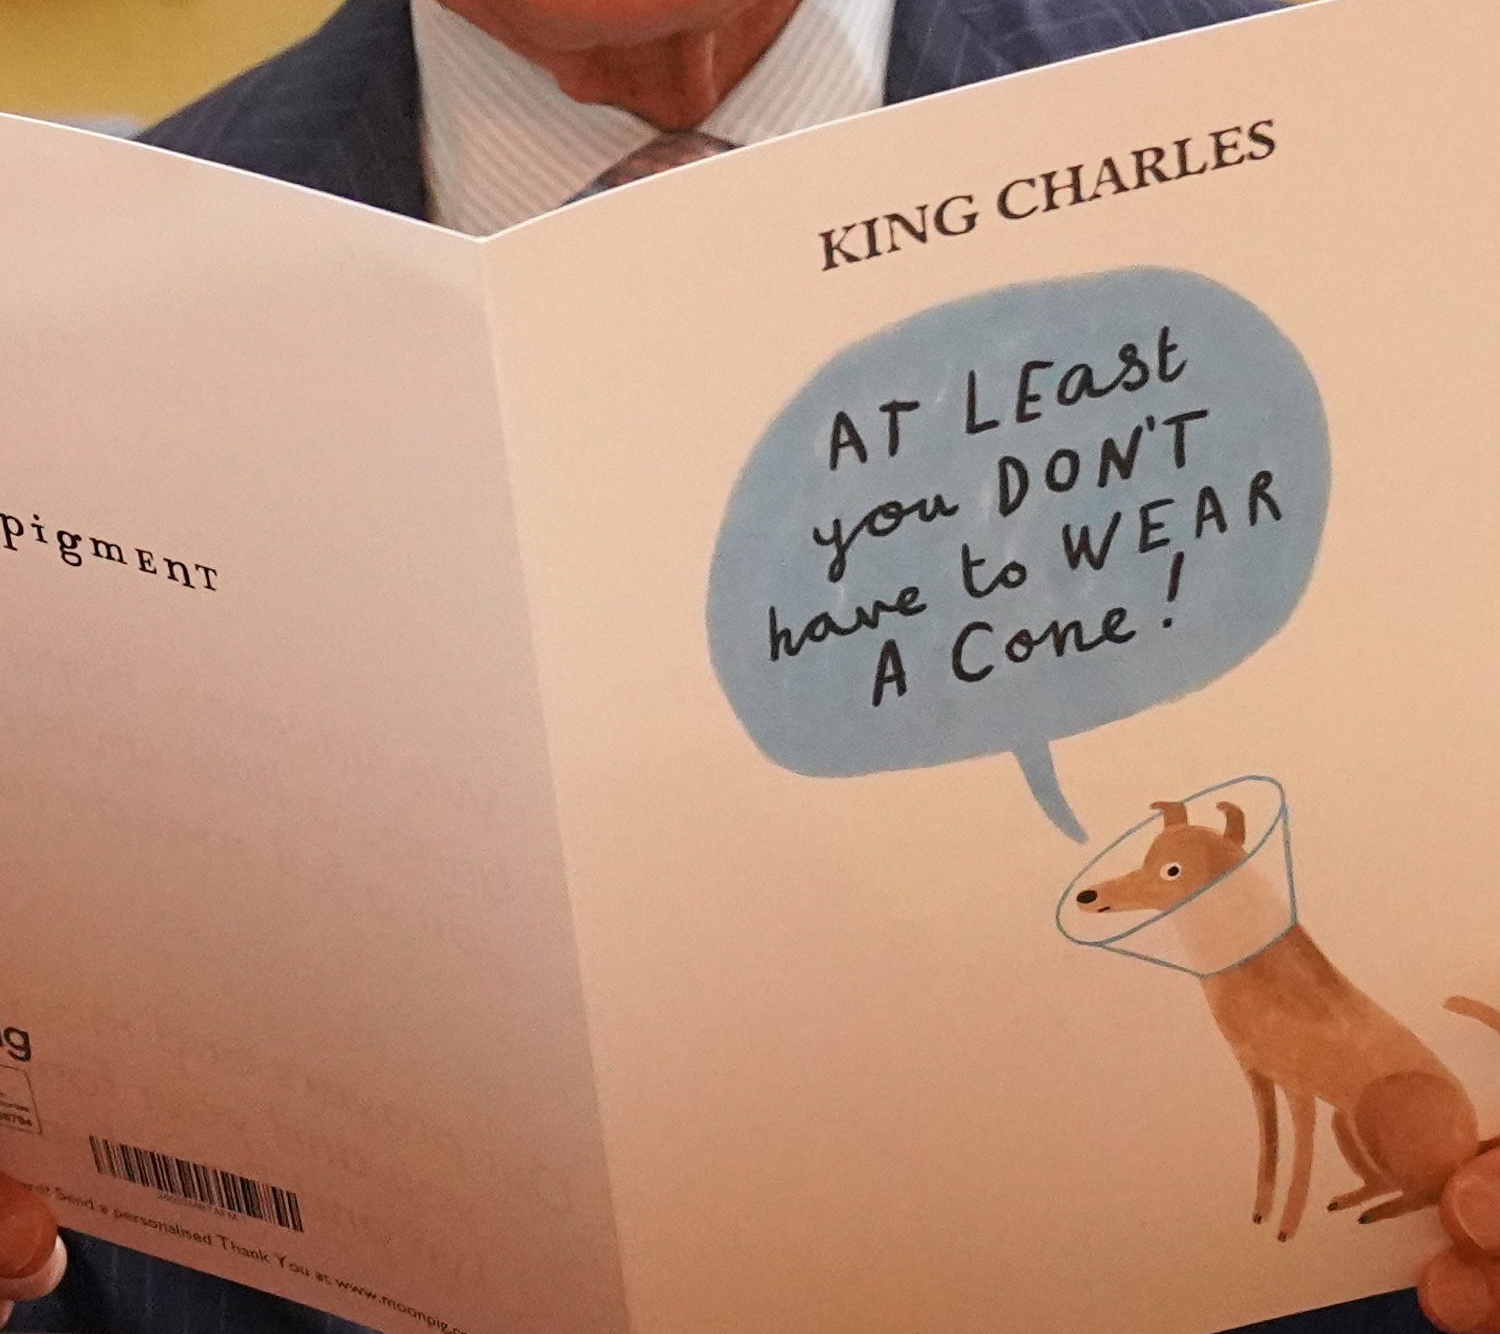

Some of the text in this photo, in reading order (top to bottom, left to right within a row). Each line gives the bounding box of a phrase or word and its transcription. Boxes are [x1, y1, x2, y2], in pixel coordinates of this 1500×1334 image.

[819, 119, 1279, 272] KING CHARLES
[827, 399, 918, 470] AT
[810, 408, 1208, 581] you DON'T
[767, 468, 1283, 663] have to WEAR
[871, 641, 908, 706] A
[113, 1208, 213, 1246] personalised
[216, 1234, 270, 1264] Thank
[276, 1254, 311, 1279] You
